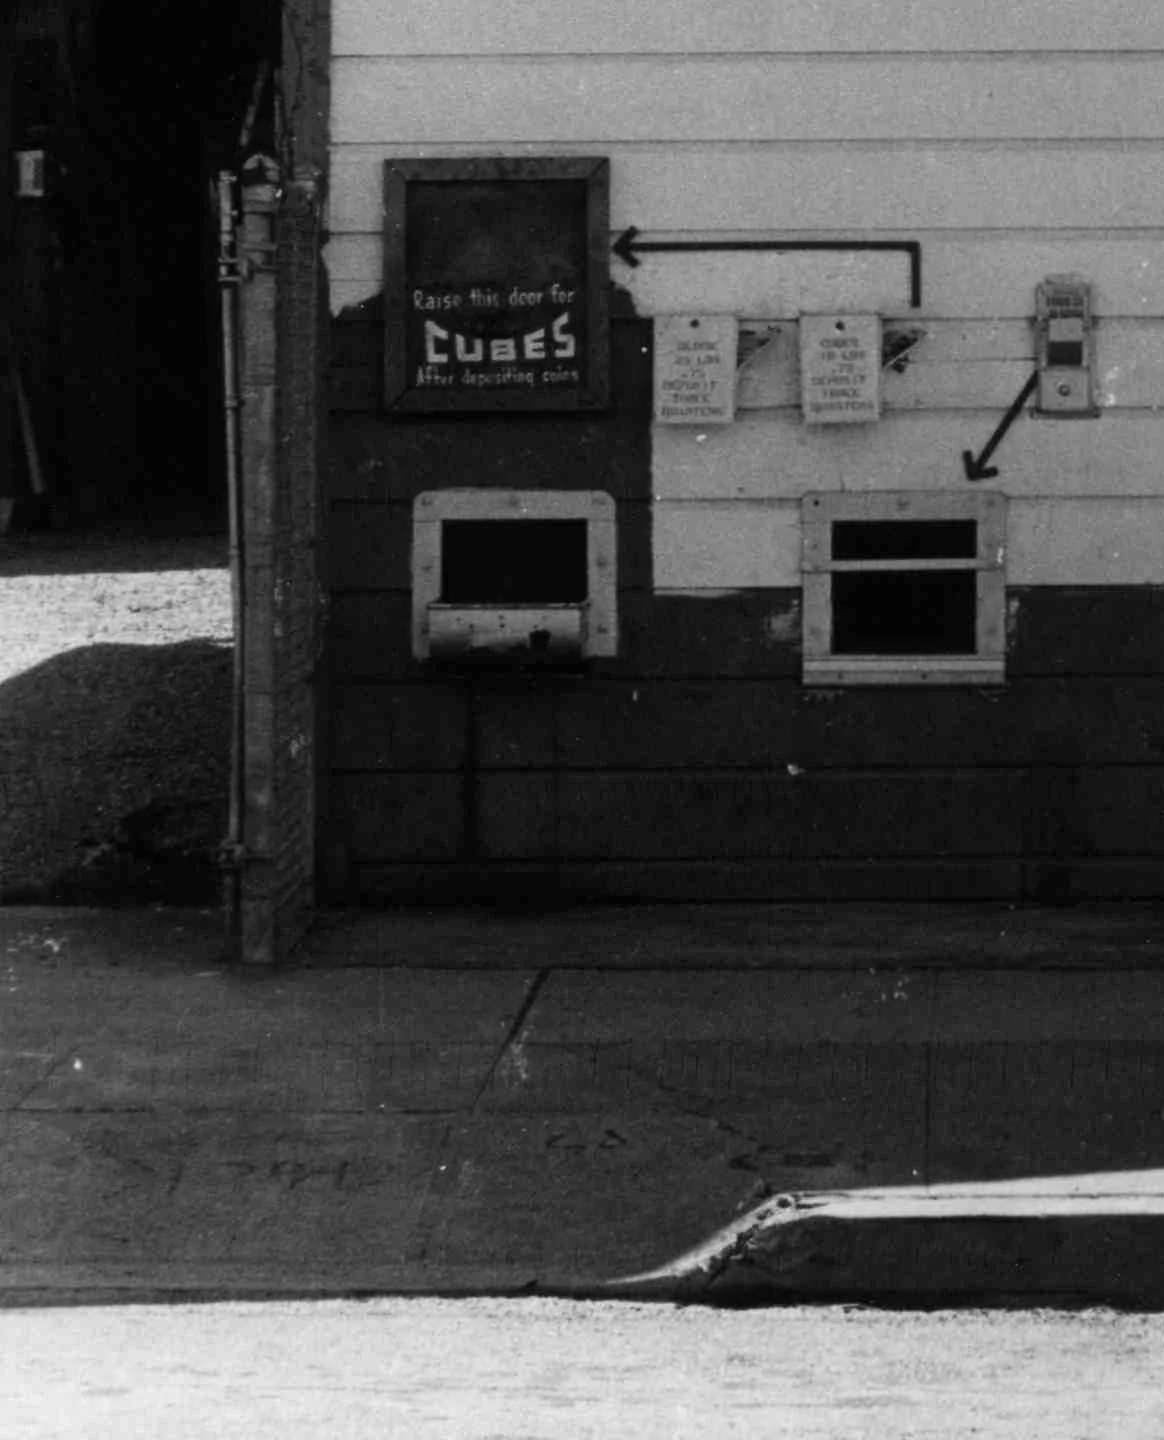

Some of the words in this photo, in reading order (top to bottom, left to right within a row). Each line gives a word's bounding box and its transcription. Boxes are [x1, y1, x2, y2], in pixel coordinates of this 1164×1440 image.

[413, 289, 463, 310] Raise
[469, 287, 500, 307] this
[508, 286, 544, 306] door
[550, 282, 576, 304] for
[424, 312, 576, 363] CUBES
[461, 366, 535, 388] depositing
